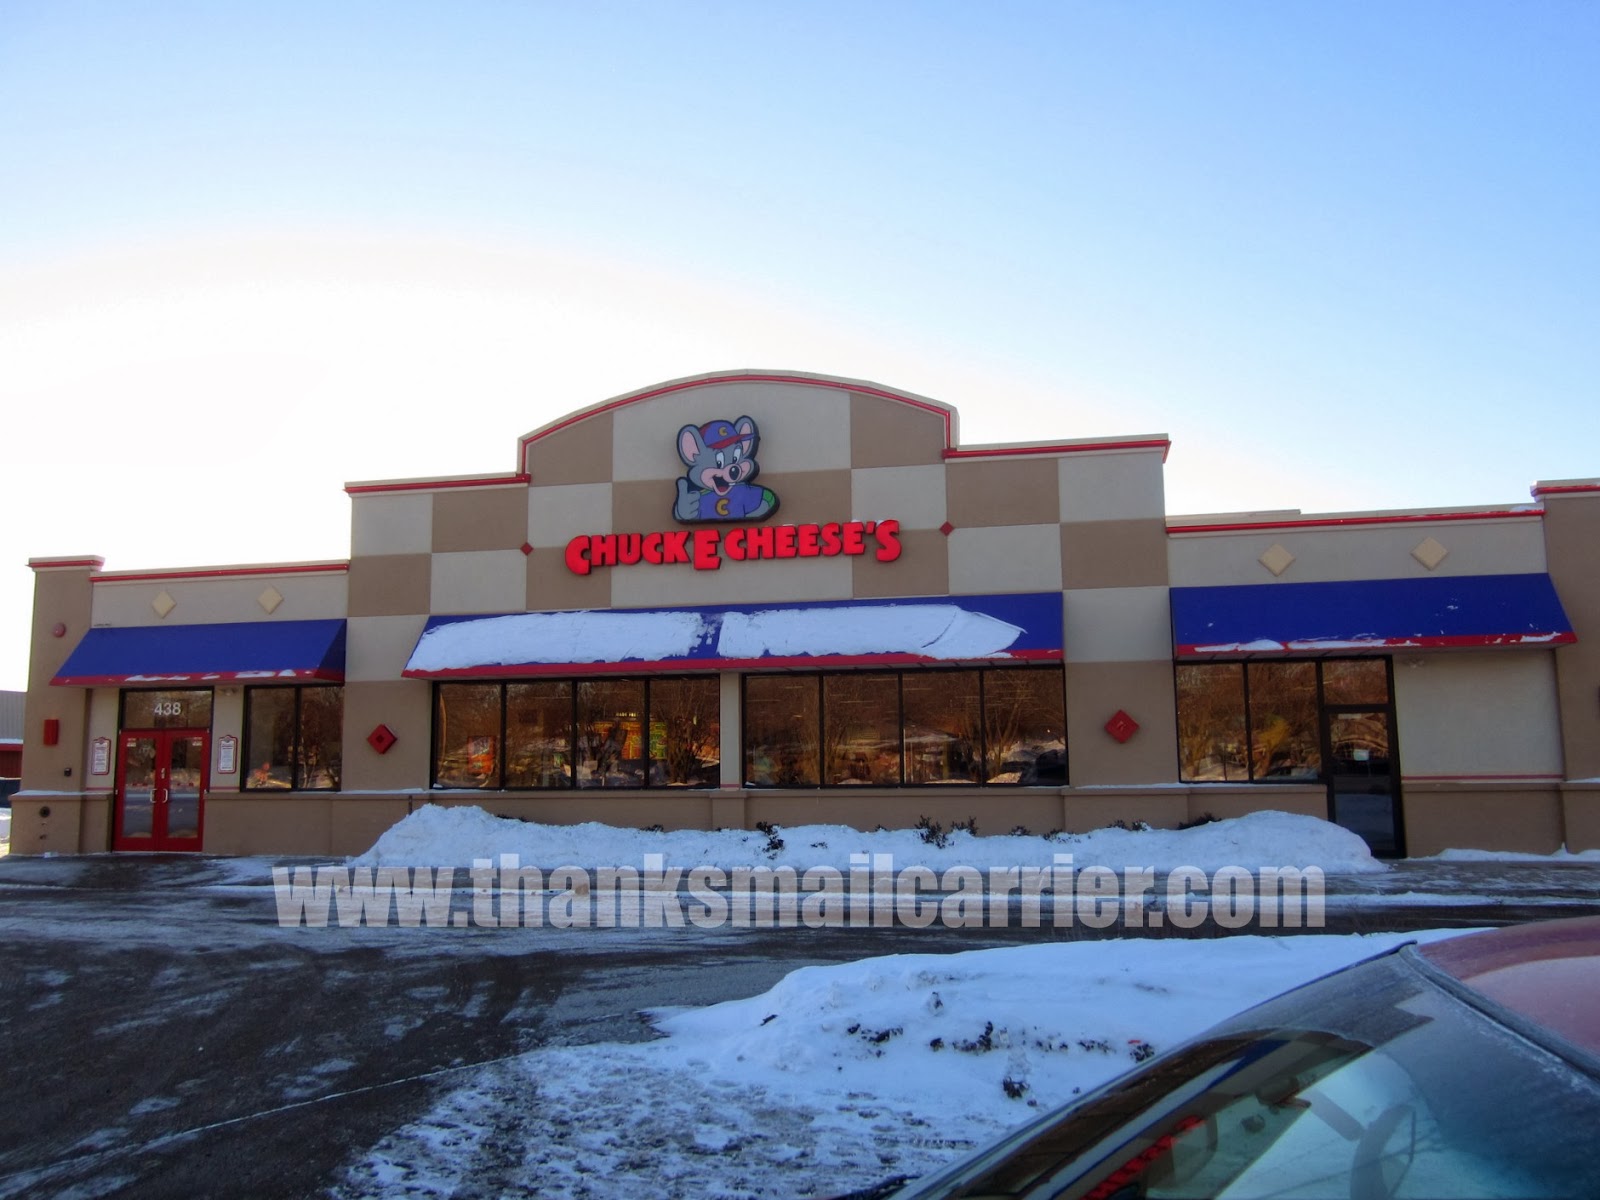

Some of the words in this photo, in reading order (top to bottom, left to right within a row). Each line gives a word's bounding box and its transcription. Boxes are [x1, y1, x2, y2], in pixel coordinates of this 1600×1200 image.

[715, 498, 730, 516] C
[564, 530, 691, 575] CHUCK
[693, 529, 721, 570] E
[724, 519, 902, 562] CHEESE'S
[154, 702, 181, 716] 438
